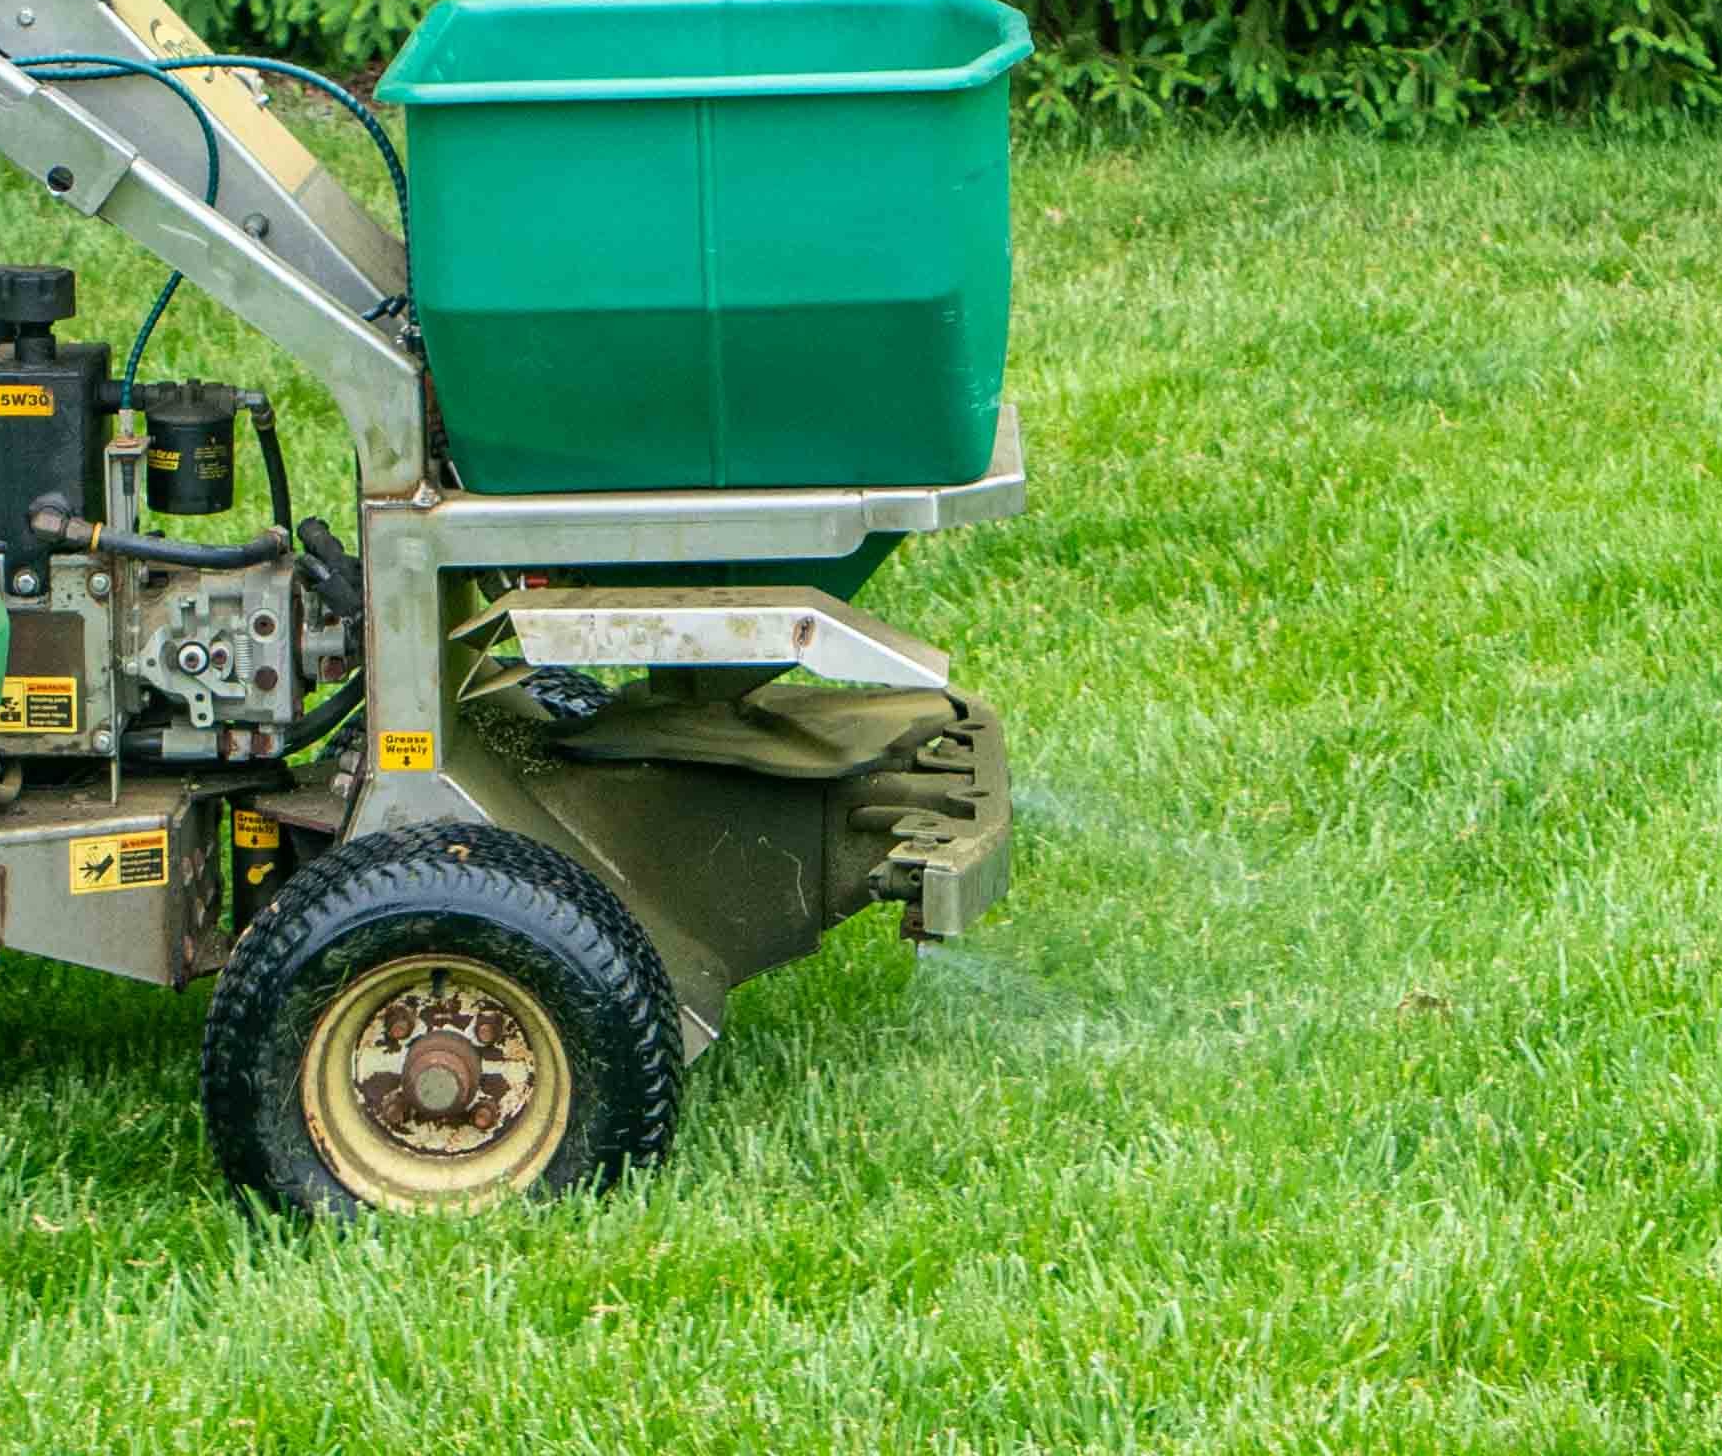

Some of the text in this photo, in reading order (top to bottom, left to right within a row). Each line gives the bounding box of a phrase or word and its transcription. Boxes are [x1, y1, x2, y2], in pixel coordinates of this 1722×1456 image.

[0, 393, 50, 406] 5W30
[385, 734, 428, 744] Grease
[385, 744, 428, 755] Weekly
